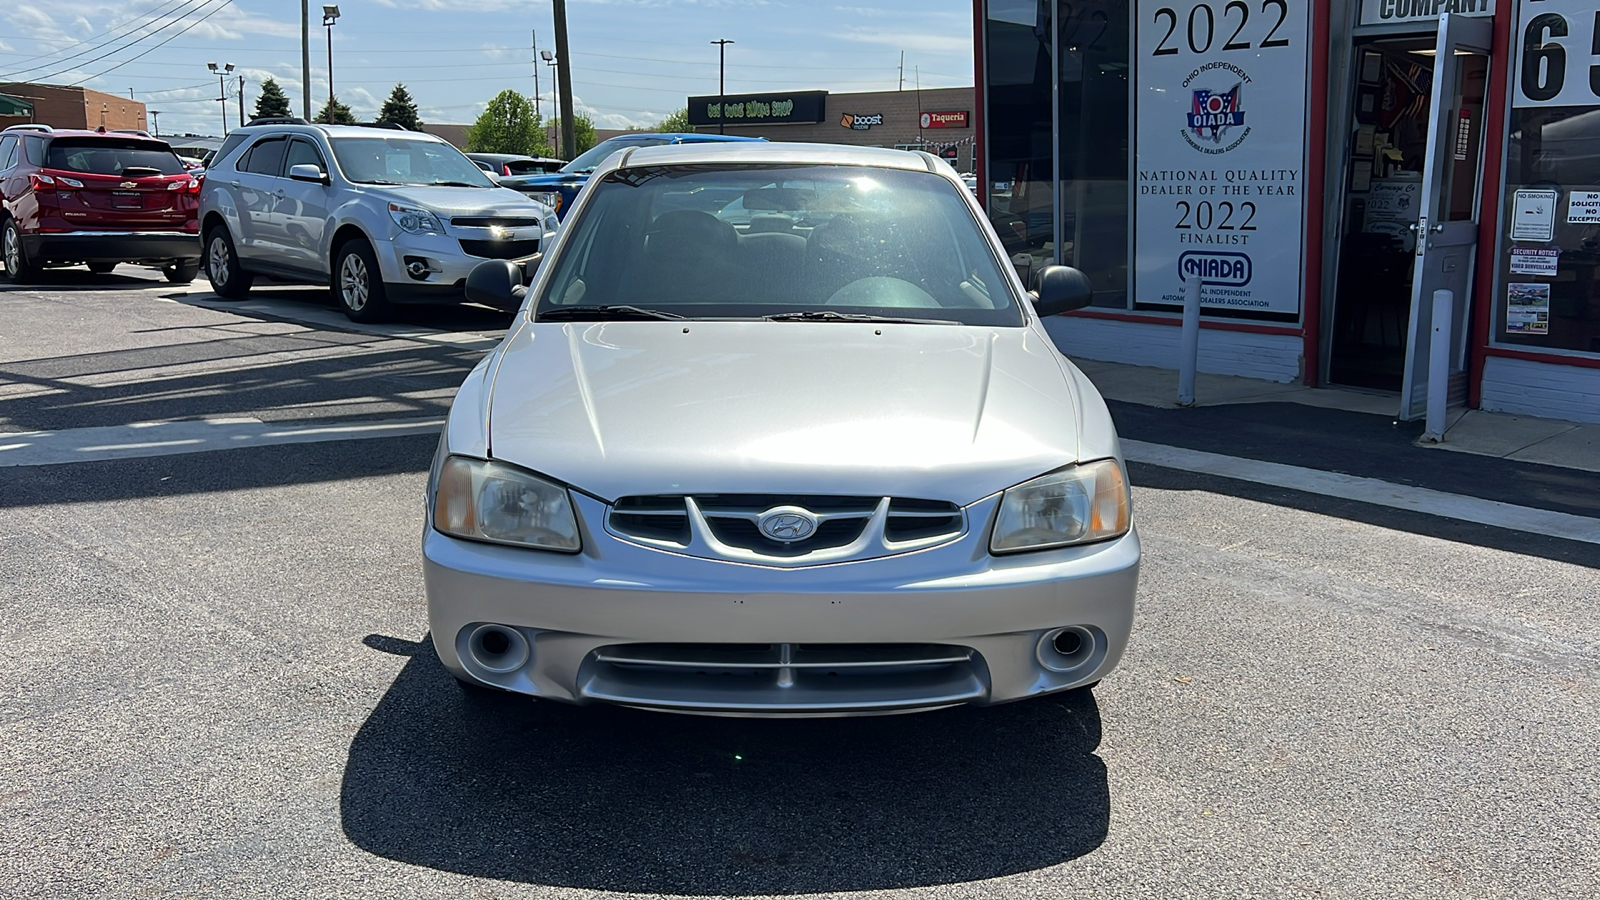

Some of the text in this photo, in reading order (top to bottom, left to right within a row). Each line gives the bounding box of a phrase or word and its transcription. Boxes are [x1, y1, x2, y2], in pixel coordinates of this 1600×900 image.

[1152, 0, 1289, 56] 2022
[1182, 61, 1252, 88] OHIO INDEPENDENT
[854, 114, 882, 124] boost
[931, 112, 964, 123] Taqueria
[1193, 113, 1235, 127] OIADA
[1180, 129, 1203, 152] AUTOMOBILE
[1225, 126, 1251, 152] ASSOCIATION
[1139, 169, 1298, 182] NATIONAL QUALITY
[1141, 185, 1295, 196] DEALER OF THE YEAR
[1175, 200, 1257, 231] 2022
[1180, 233, 1249, 245] FINALIST
[1184, 258, 1244, 279] NIADA
[1209, 288, 1251, 297] INDEPENDENT
[1200, 297, 1225, 305] DEALERS
[1227, 299, 1269, 307] ASSOCIATION
